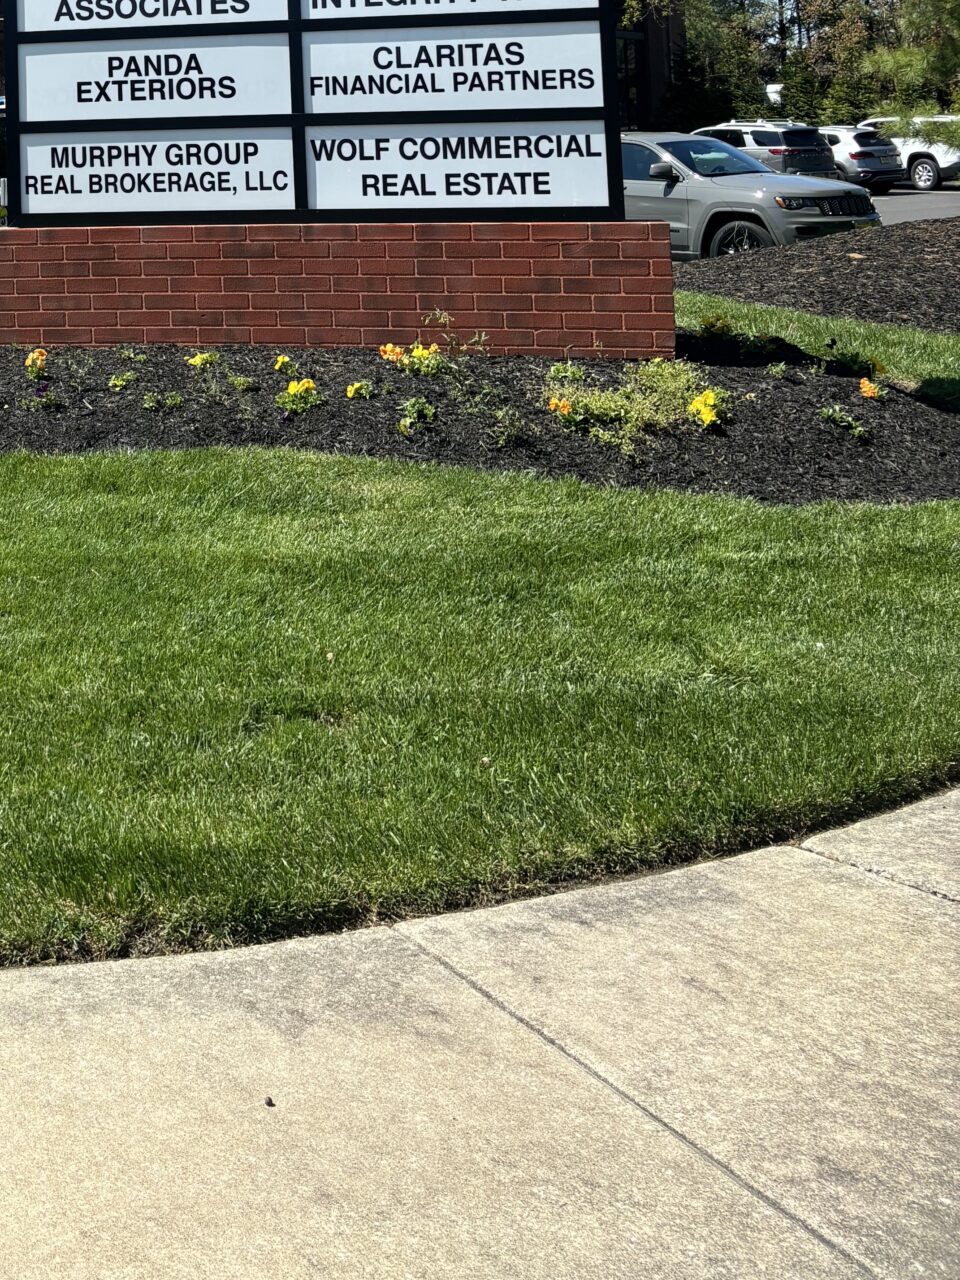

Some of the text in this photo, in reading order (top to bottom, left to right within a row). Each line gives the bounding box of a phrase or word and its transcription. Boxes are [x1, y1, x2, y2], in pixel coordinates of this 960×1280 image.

[107, 53, 204, 78] PANDA
[372, 41, 525, 70] CLARITAS
[76, 75, 237, 103] EXTERIORS
[309, 68, 595, 97] FINANCIAL PARTNERS
[50, 142, 259, 169] MURPHY GROUP
[309, 133, 602, 162] WOLF COMMERCIAL
[24, 170, 289, 196] REAL BROKERAGE, LLC
[361, 171, 551, 197] REAL ESTATE
